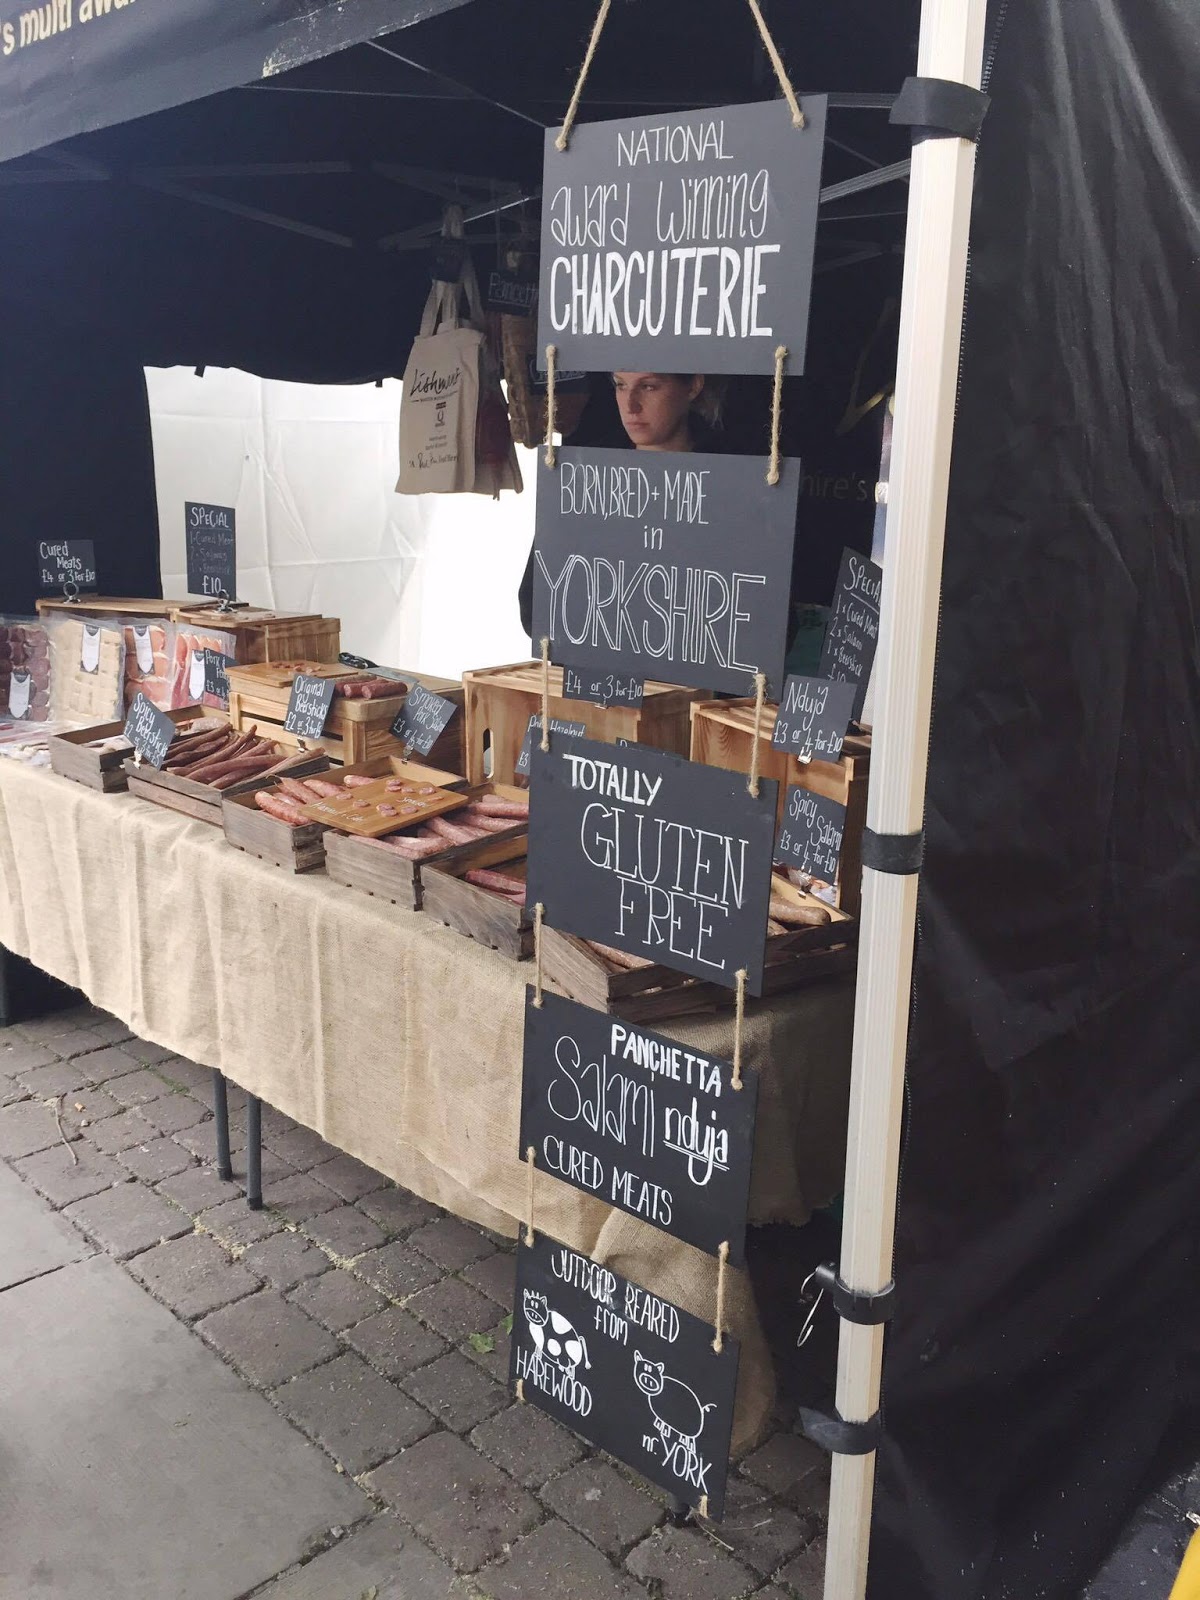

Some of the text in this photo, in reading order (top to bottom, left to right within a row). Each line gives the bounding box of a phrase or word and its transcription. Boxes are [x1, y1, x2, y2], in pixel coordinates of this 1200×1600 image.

[20, 0, 72, 48] multi
[617, 120, 734, 167] NATIONAL
[551, 182, 631, 247] award
[550, 244, 781, 338] CHARCUTERIE
[663, 470, 710, 525] MADE
[40, 541, 69, 560] Cured
[643, 525, 664, 550] in
[42, 569, 54, 583] £4
[58, 573, 65, 582] or
[66, 569, 75, 582] 3
[56, 556, 82, 570] Meats
[202, 575, 222, 595] £10
[535, 550, 766, 674] YORKSHIRE
[829, 616, 839, 637] 2
[847, 602, 866, 629] Cured
[295, 675, 326, 704] Original
[565, 669, 643, 700] £4 or 3 for £10
[133, 692, 156, 731] Spicy
[285, 711, 297, 731] £2
[302, 716, 311, 735] 3
[394, 718, 406, 734] £3
[773, 720, 844, 754] £3 or 4 for £10
[562, 753, 663, 806] TOTALLY
[789, 789, 818, 829] Spicy
[581, 803, 750, 910] GLUTEN
[780, 829, 791, 851] £3
[793, 842, 803, 855] or
[813, 844, 825, 866] for
[824, 848, 837, 874] £10
[615, 876, 728, 969] FREE
[611, 1023, 722, 1098] PANCHETTA
[548, 1035, 655, 1158] Salami
[543, 1135, 604, 1190] CURED
[663, 1097, 729, 1186] nduja
[611, 1166, 673, 1226] MEATS
[593, 1305, 629, 1346] from
[624, 1281, 680, 1343] REARED
[516, 1346, 593, 1417] HAREWOOD
[660, 1433, 712, 1494] YORK
